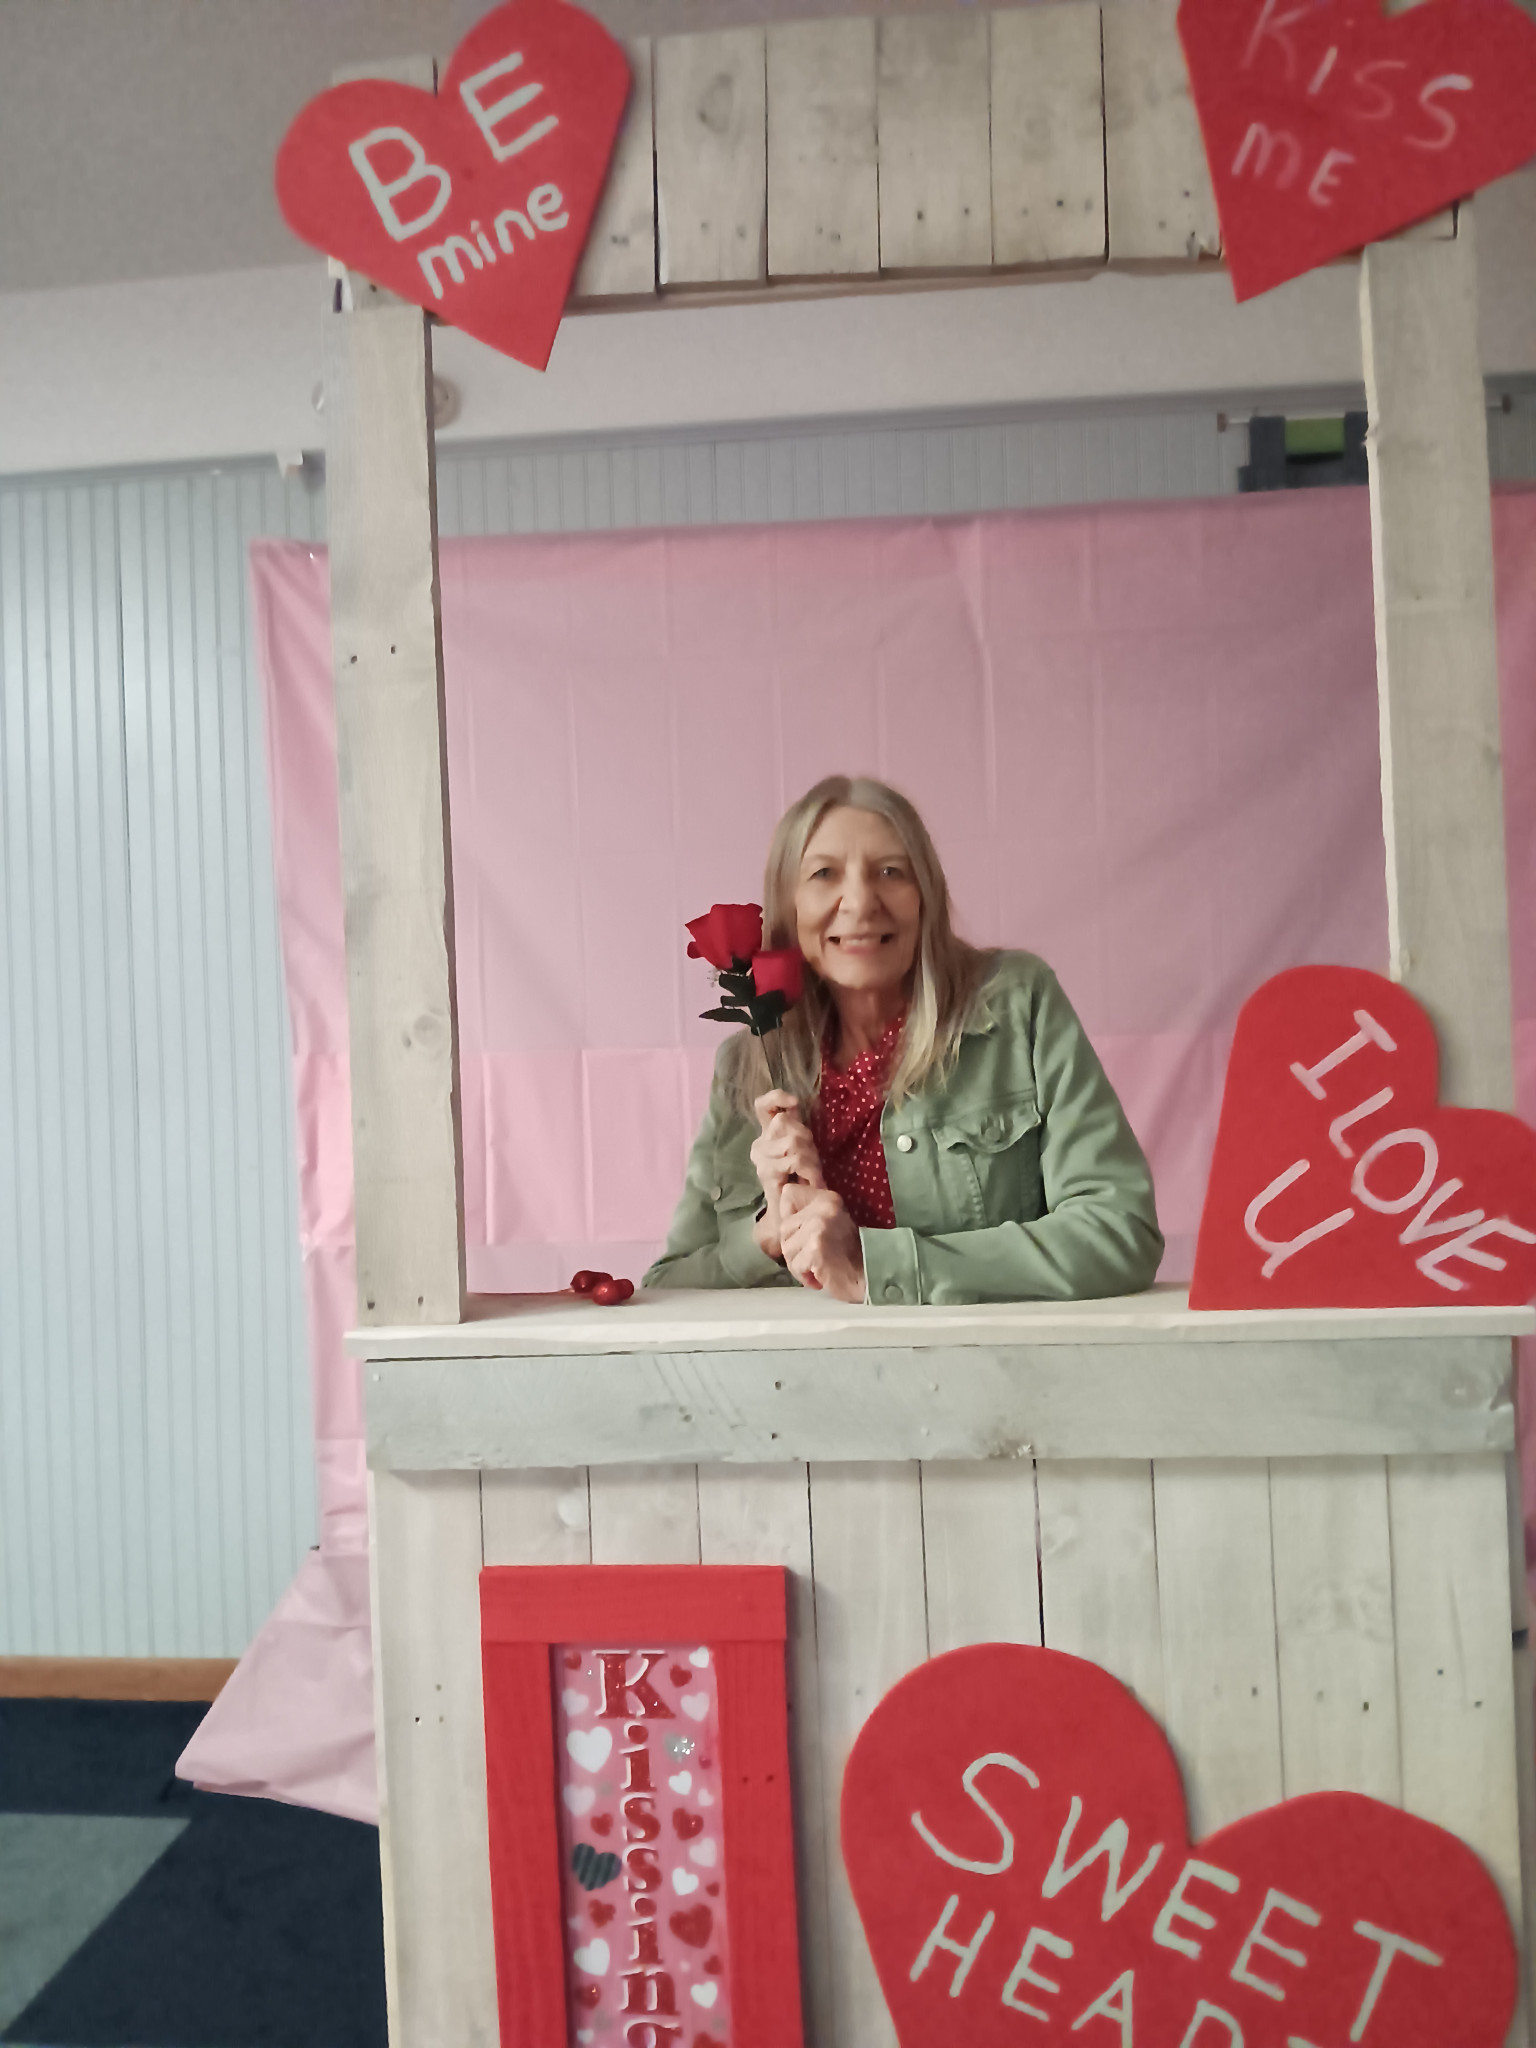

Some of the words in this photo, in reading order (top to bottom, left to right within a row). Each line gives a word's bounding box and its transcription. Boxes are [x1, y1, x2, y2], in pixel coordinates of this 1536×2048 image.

[348, 51, 560, 242] BE
[417, 182, 570, 300] mine
[1289, 1008, 1398, 1101] I
[1328, 1086, 1536, 1292] LOVE
[909, 1894, 1325, 2048] HEAR
[910, 1752, 1444, 2042] SWEET
